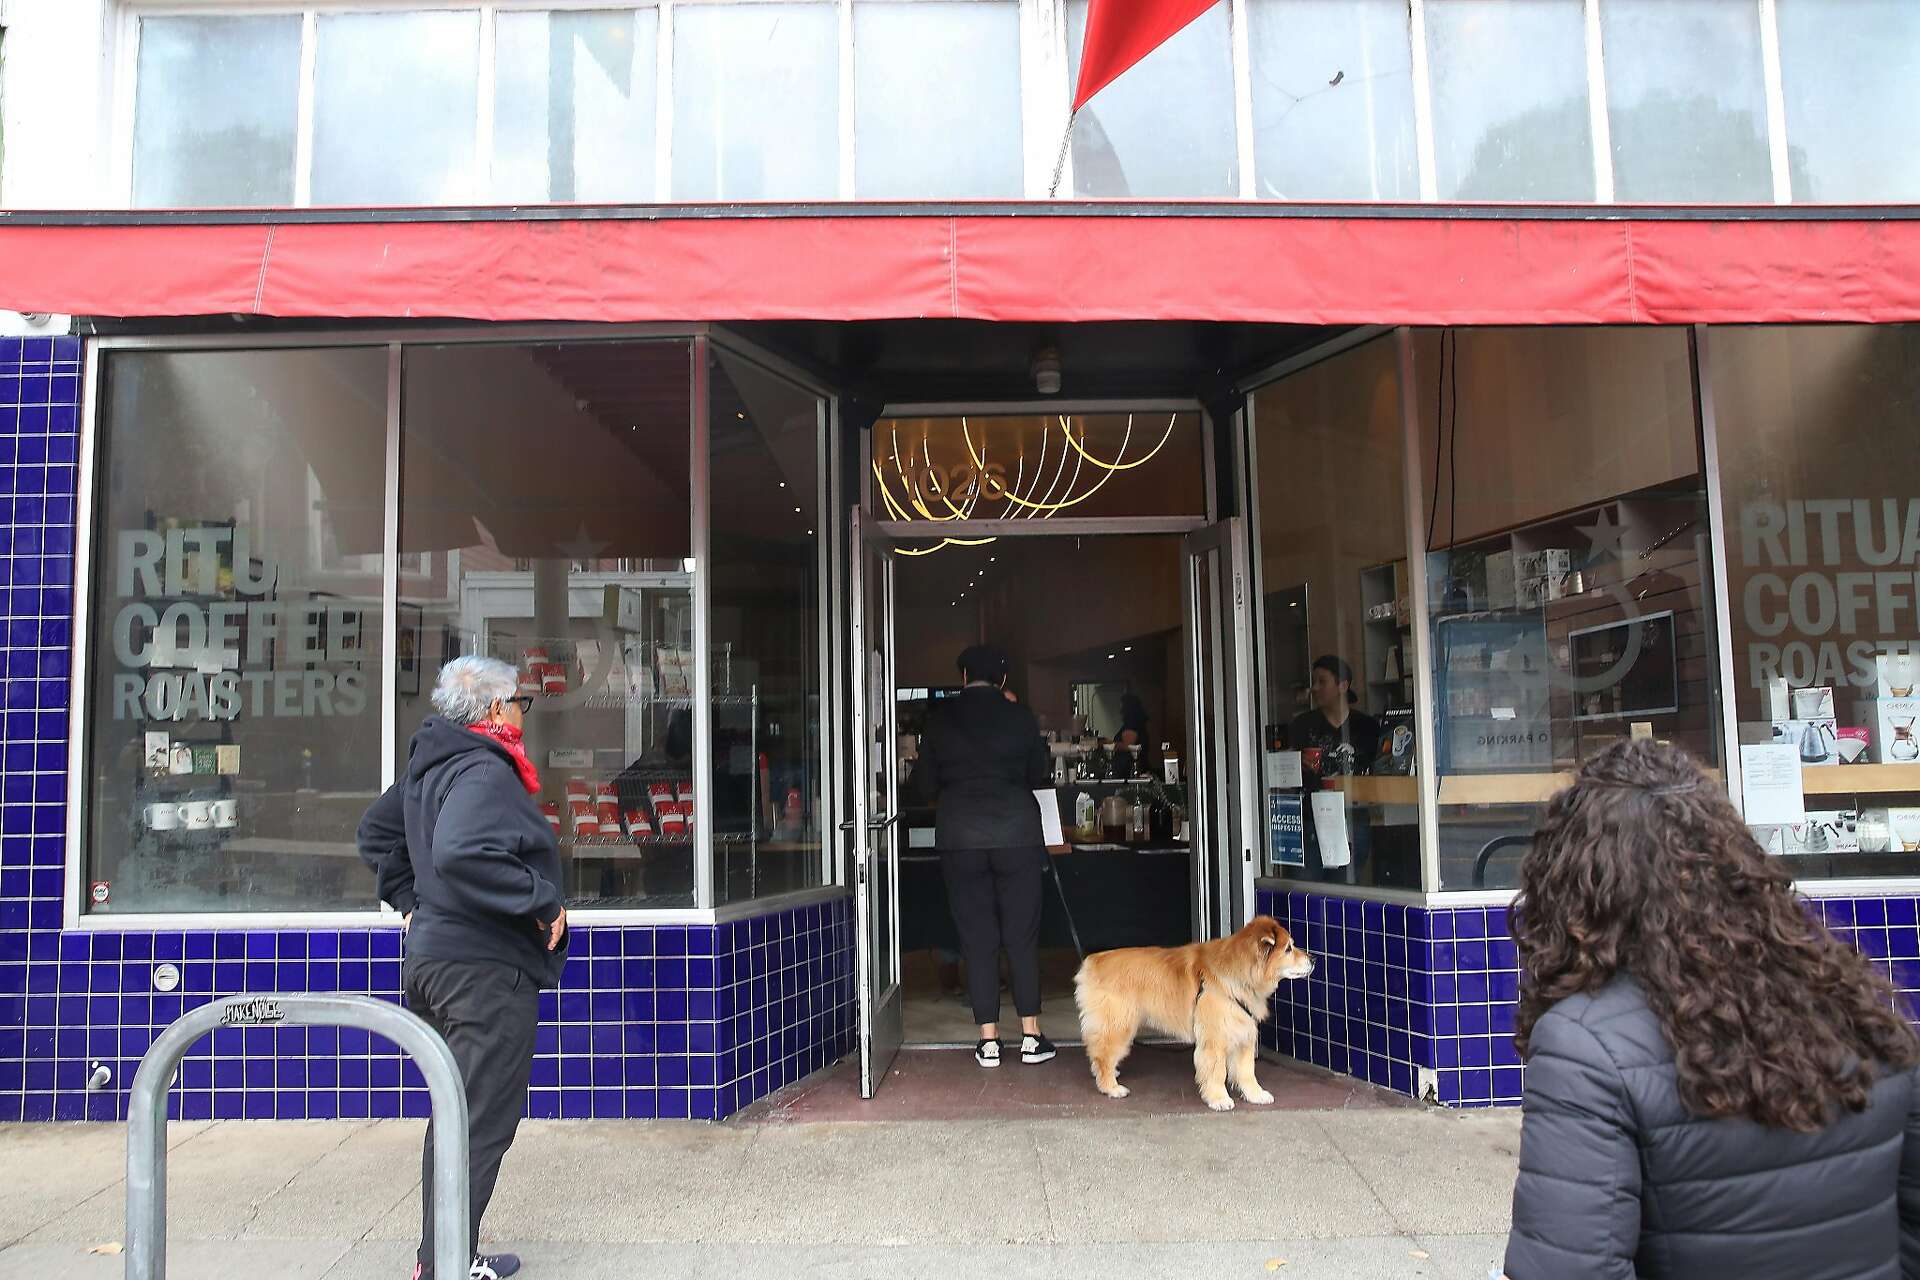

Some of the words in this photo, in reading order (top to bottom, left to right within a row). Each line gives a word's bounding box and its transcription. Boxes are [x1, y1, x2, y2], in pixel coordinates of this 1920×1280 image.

[901, 463, 1008, 501] 1026
[1744, 571, 1920, 637] COFF
[113, 671, 367, 721] ROASTERS
[1271, 814, 1301, 825] ACCESS
